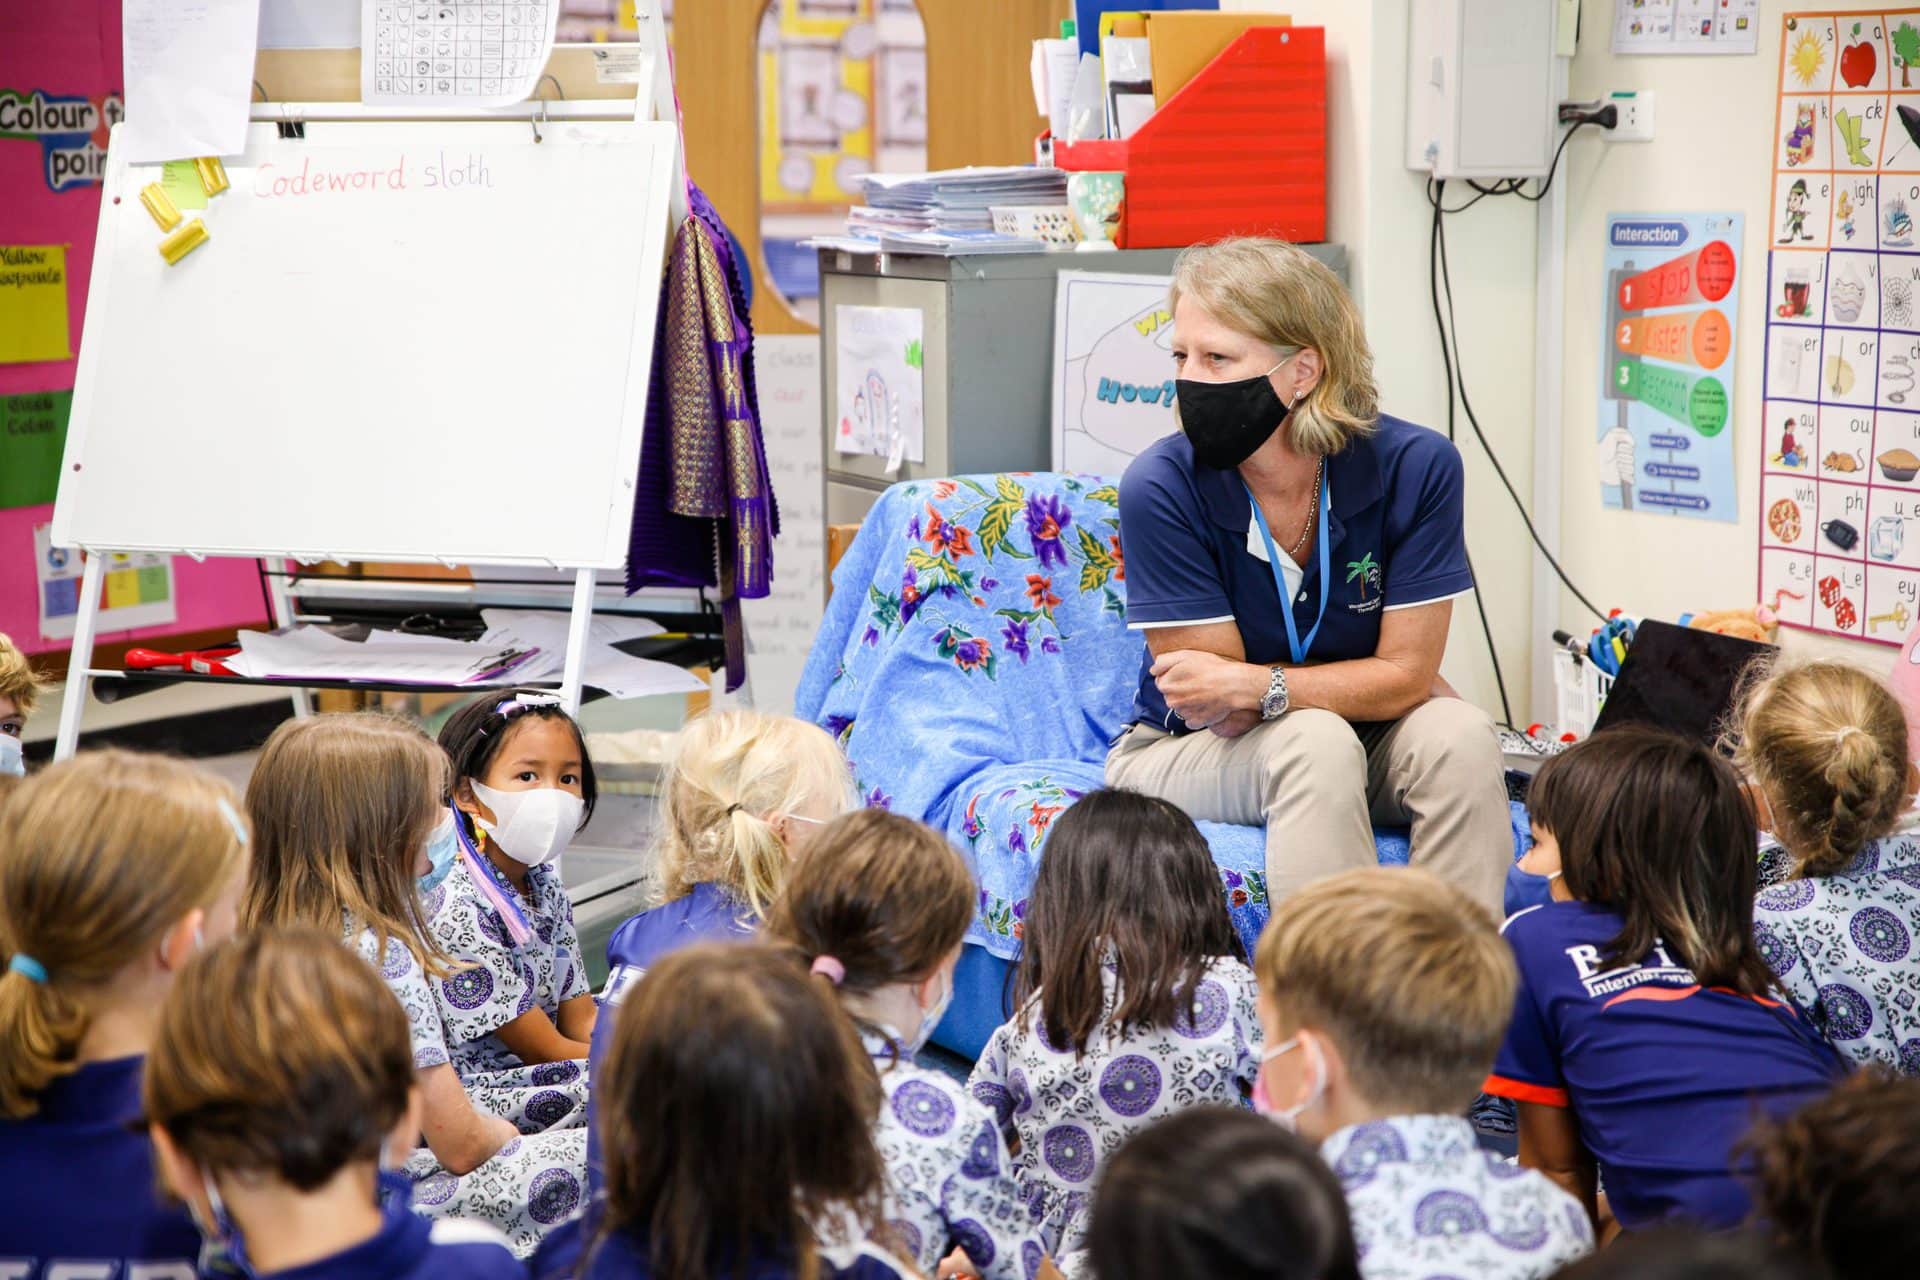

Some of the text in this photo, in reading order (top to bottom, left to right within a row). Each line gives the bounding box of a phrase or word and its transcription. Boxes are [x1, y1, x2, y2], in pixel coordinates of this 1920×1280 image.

[0, 95, 93, 130] Colour
[1865, 98, 1883, 120] ck
[256, 150, 493, 198] Codeword sloth
[1821, 184, 1829, 198] e
[1854, 178, 1874, 206] igh
[1615, 225, 1679, 242] Interaction
[1624, 284, 1632, 304] 1
[1621, 324, 1632, 345] 2
[1804, 338, 1818, 352] er
[1859, 341, 1874, 356] or
[1619, 365, 1630, 385] 3
[1096, 376, 1178, 408] How?
[1800, 413, 1815, 435] ay
[1850, 419, 1870, 433] ou
[1845, 491, 1864, 515] ph
[1898, 580, 1916, 602] ey
